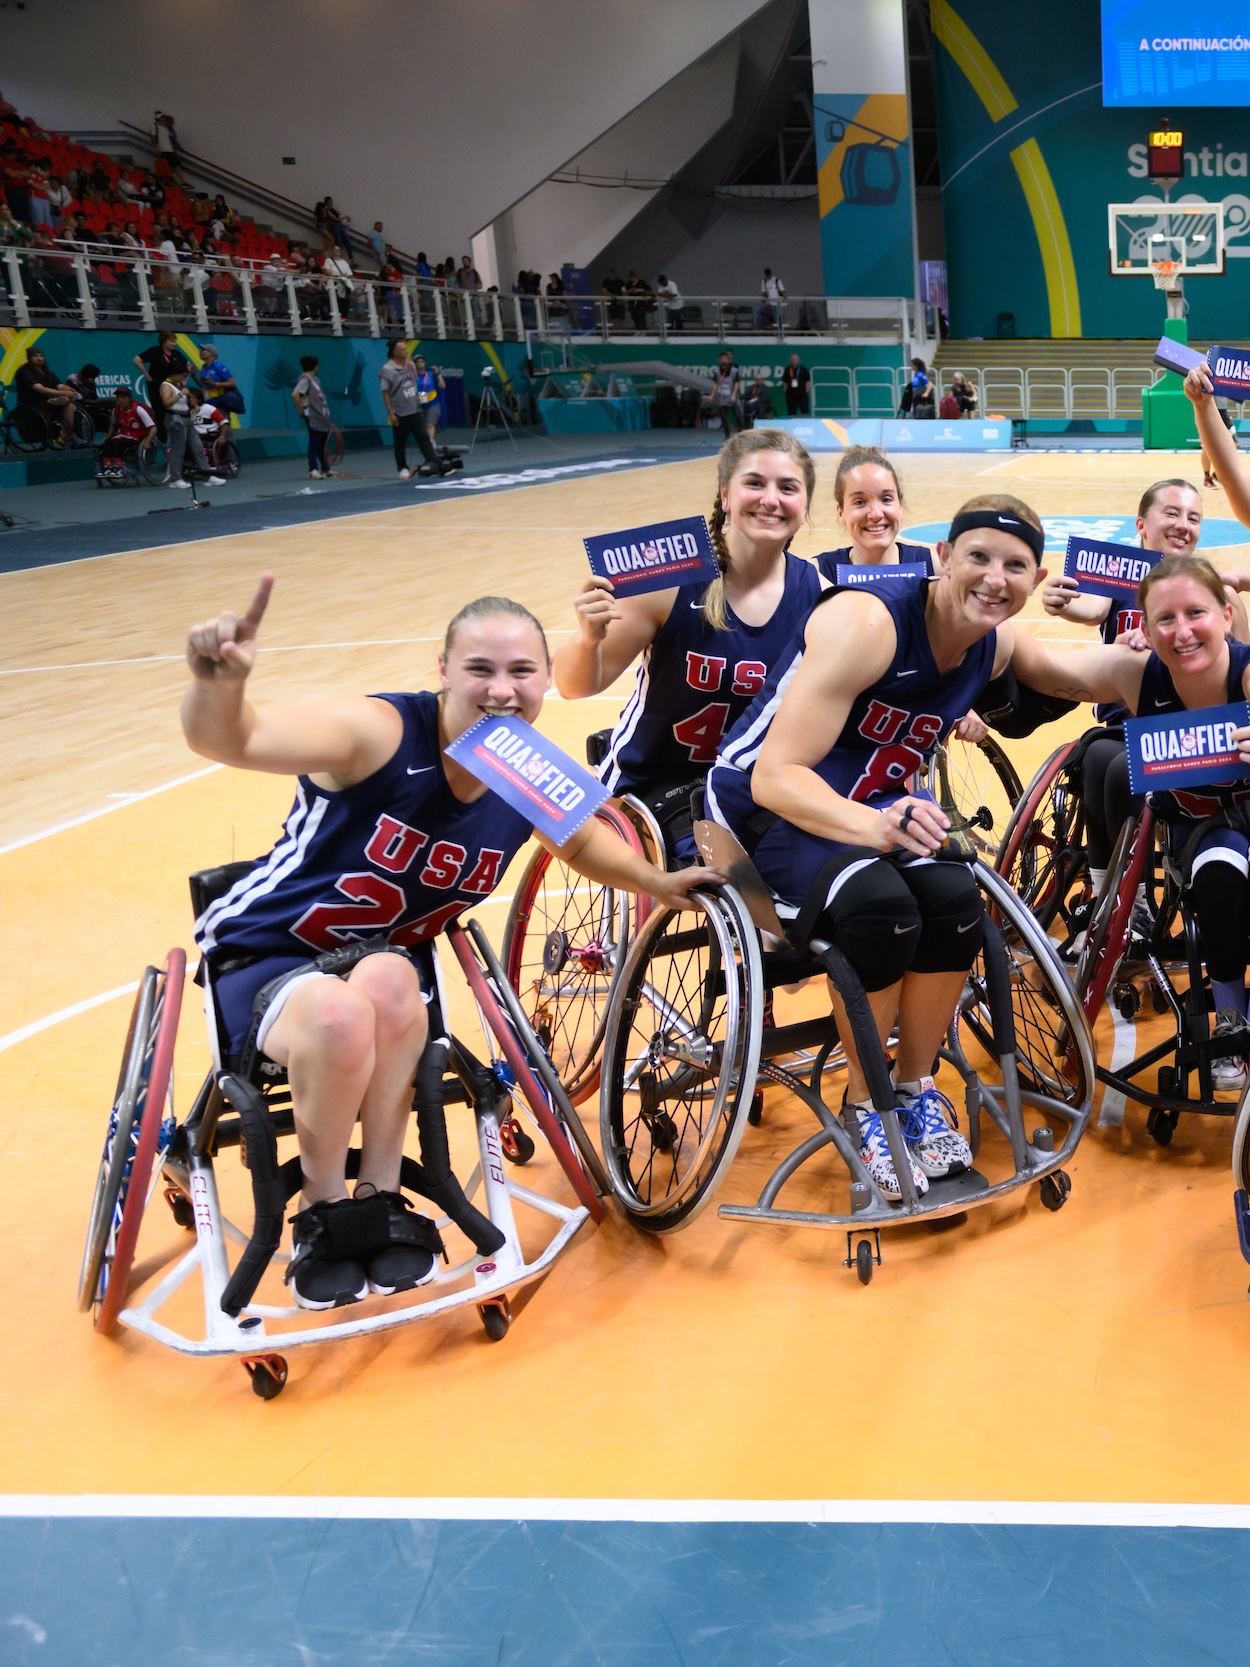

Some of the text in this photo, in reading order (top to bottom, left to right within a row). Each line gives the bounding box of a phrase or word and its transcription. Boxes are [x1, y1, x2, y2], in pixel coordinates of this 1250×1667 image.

[1139, 38, 1149, 51] A
[1152, 131, 1183, 147] 10:00
[602, 532, 699, 575] QUALIFIED
[1076, 549, 1151, 582] QUALIFIED
[686, 650, 768, 697] US
[858, 699, 966, 751] US
[1140, 721, 1238, 763] QUALIFIED
[483, 726, 586, 812] QUALIFIED
[364, 812, 505, 895] USA
[484, 1125, 505, 1185] ELITE
[193, 1176, 214, 1236] ELITE
